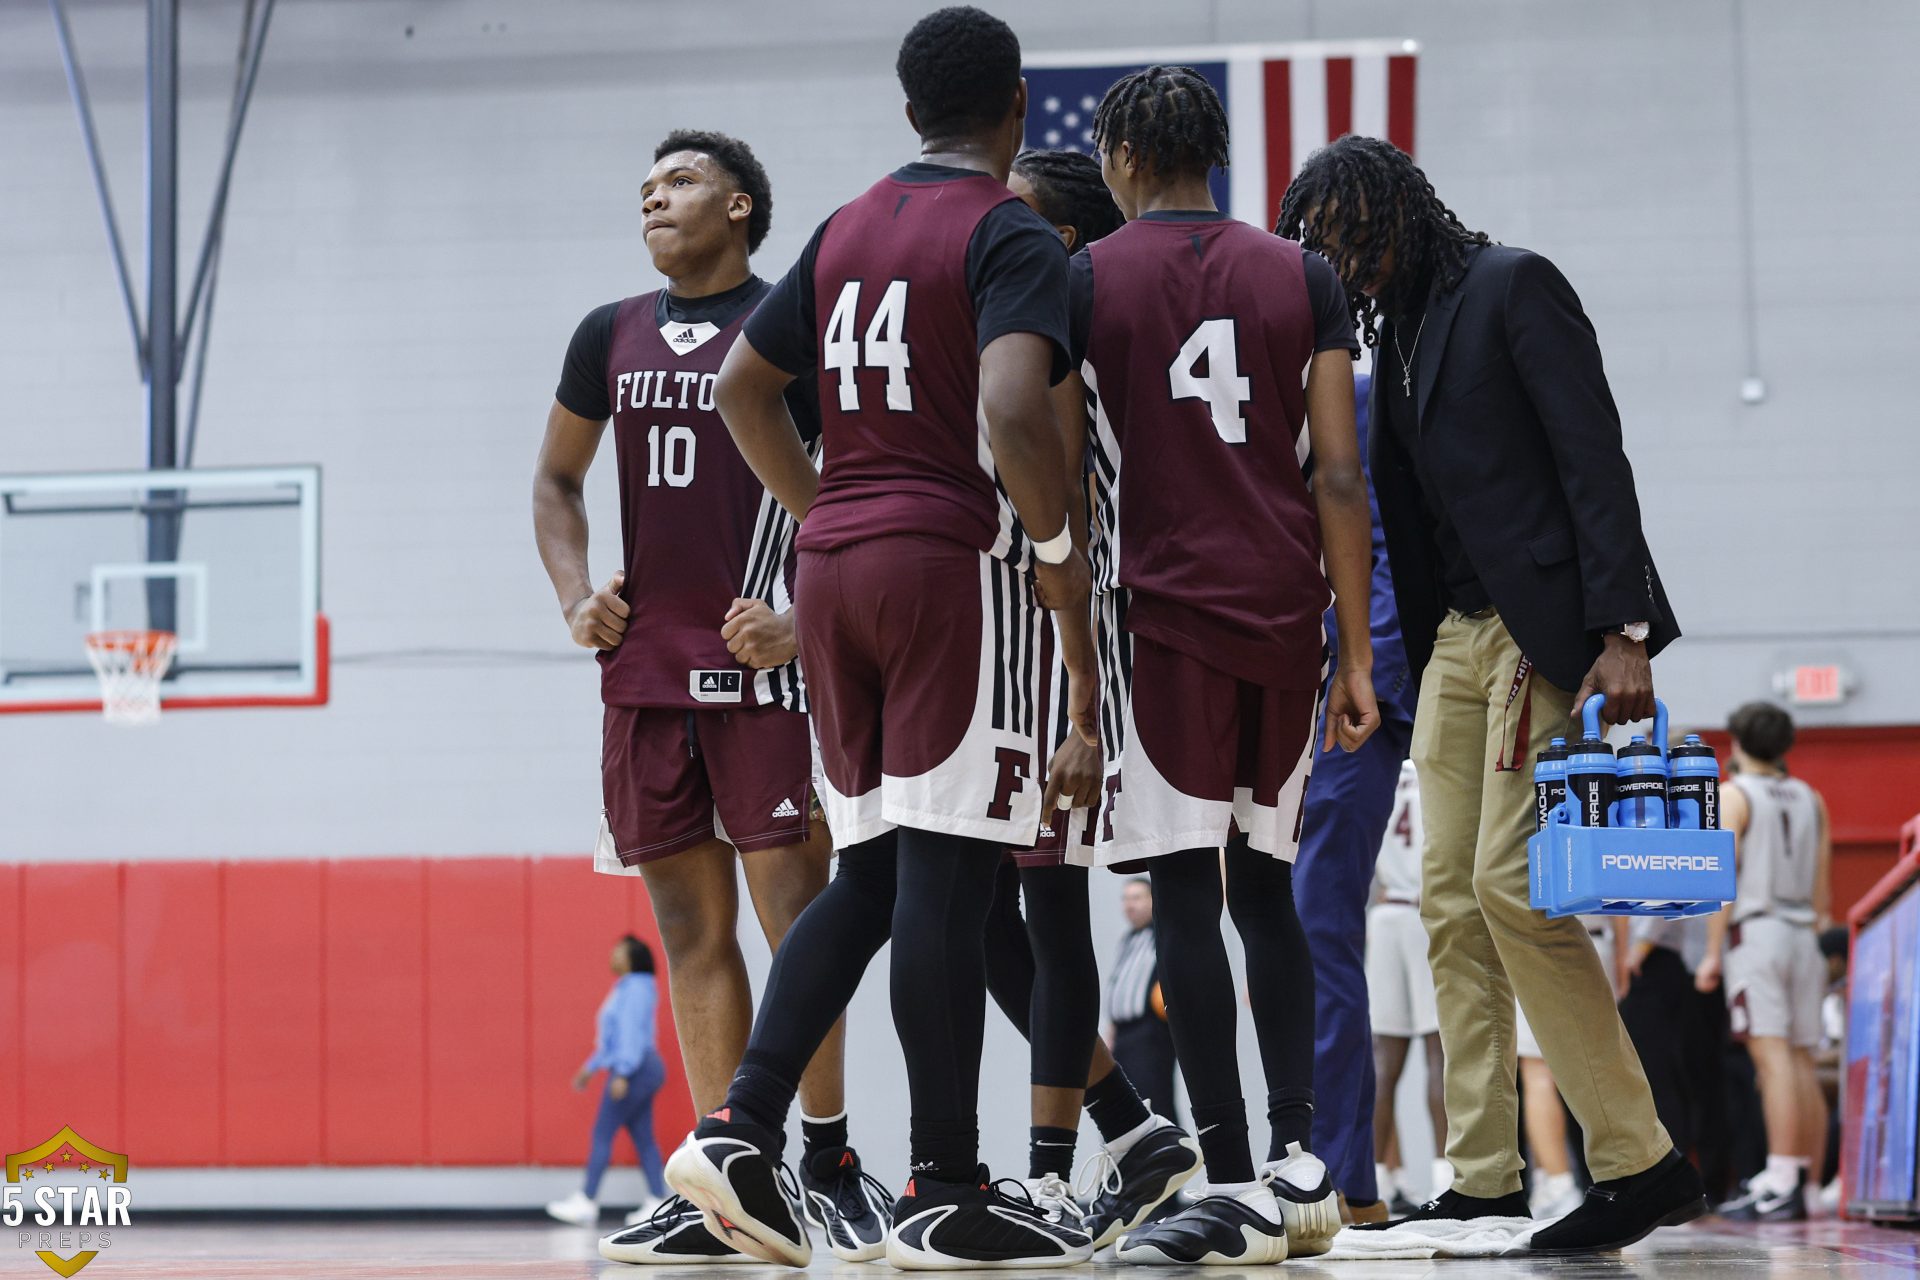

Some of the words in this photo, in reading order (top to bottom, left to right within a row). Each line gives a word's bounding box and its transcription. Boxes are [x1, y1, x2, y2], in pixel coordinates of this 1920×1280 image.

[824, 279, 913, 412] 44
[1169, 318, 1250, 443] 4
[647, 425, 697, 488] 10
[772, 809, 799, 818] adidas
[986, 746, 1031, 821] F
